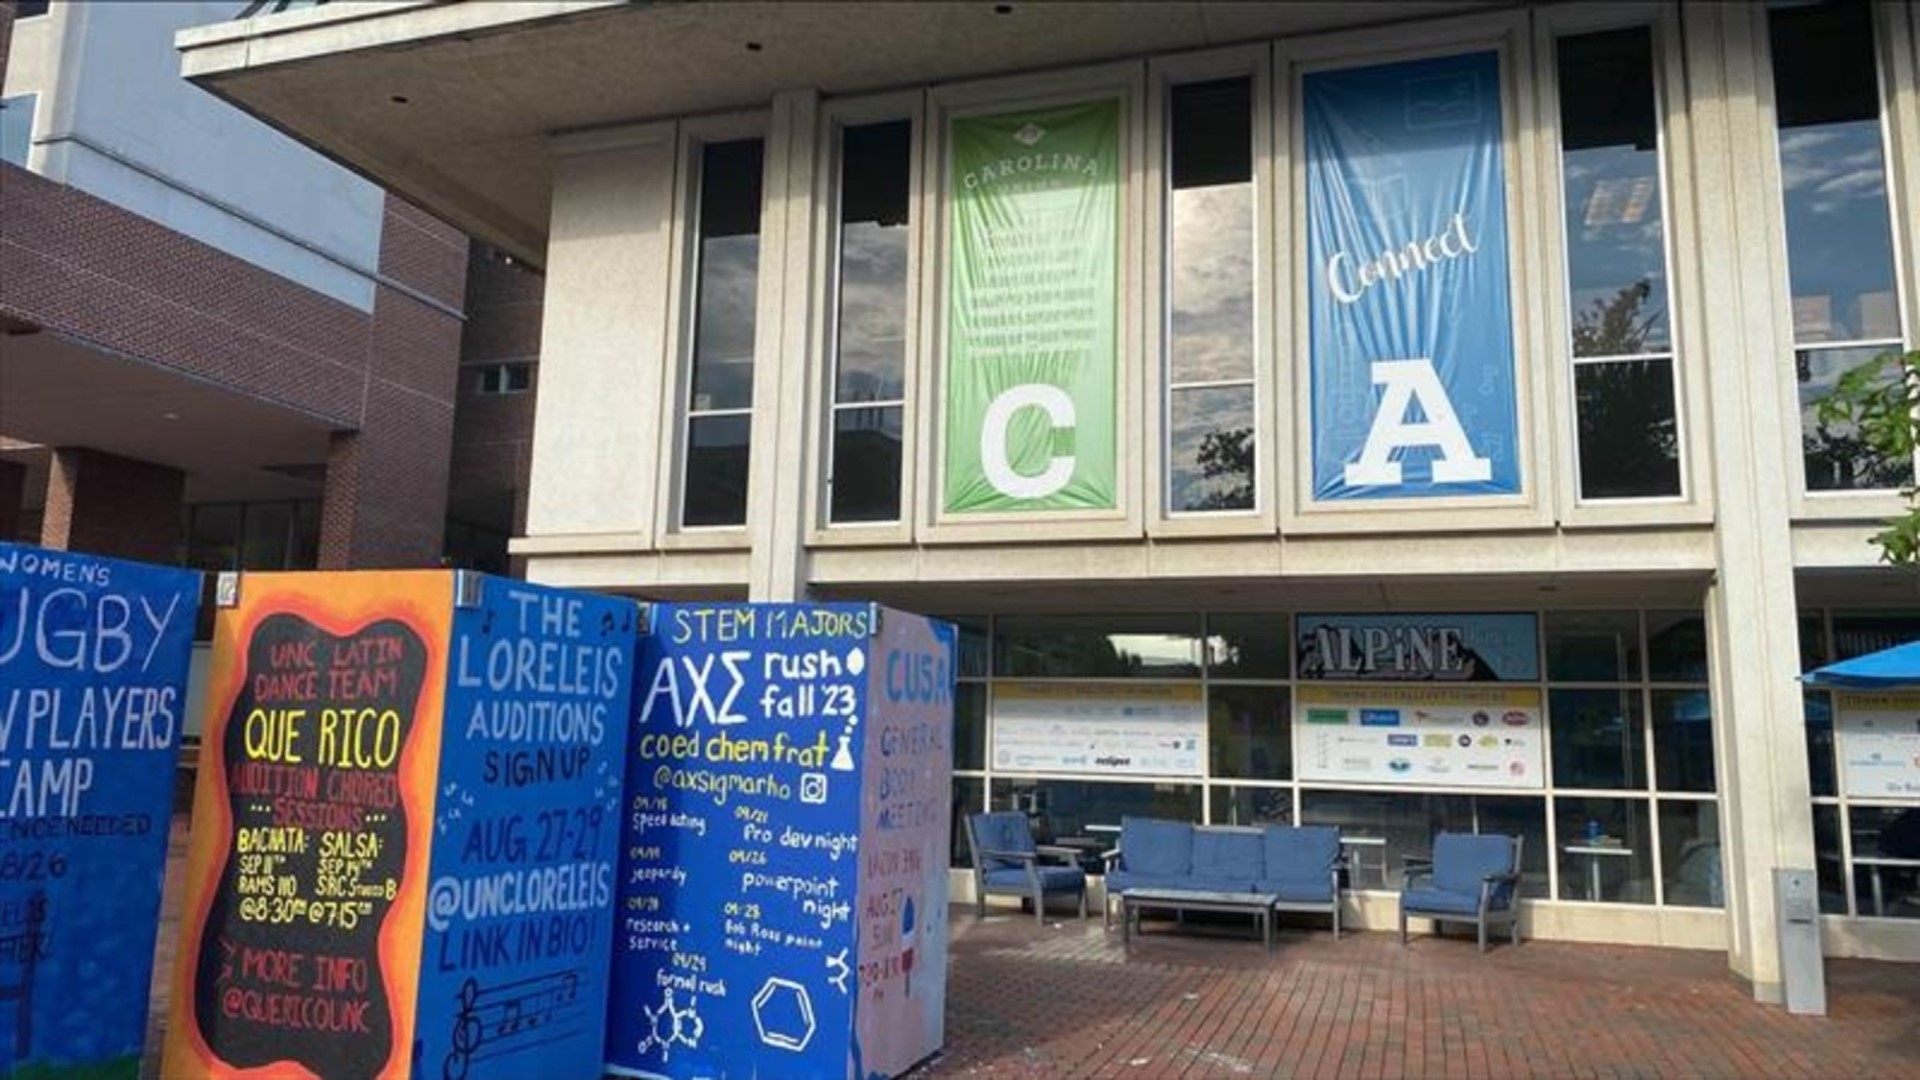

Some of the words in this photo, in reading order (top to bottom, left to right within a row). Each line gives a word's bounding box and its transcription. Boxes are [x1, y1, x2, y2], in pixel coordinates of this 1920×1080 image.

[964, 153, 1100, 190] CAROLINA
[1329, 211, 1480, 303] Connect
[1345, 357, 1492, 486] A
[981, 383, 1077, 500] C
[508, 589, 584, 639] THE
[672, 607, 757, 645] STEM
[765, 609, 868, 640] MAJORS
[270, 641, 317, 669] UNC
[333, 636, 405, 667] LATIN
[456, 633, 624, 700] LORELEIS
[763, 649, 844, 681] rush
[254, 671, 319, 701] DANCE
[328, 668, 399, 699] TEAM
[886, 649, 948, 707] CUSA
[25, 686, 176, 750] PLAYERS
[759, 682, 817, 720] fall
[244, 707, 307, 764] QUE
[317, 706, 400, 769] RICO
[464, 699, 608, 747] AUDITIONS
[880, 722, 944, 758] GENERAL
[482, 746, 556, 789] SIGN
[559, 744, 592, 782] UP
[640, 729, 700, 760] coed
[704, 729, 770, 762] chem
[772, 729, 831, 768] frat
[234, 761, 320, 799] AUDITION
[326, 768, 399, 810] CHOREO
[652, 764, 792, 806] @axsigmarho
[272, 797, 365, 832] SESSIONS
[318, 830, 385, 859] SALSA:
[461, 813, 528, 867] AUG
[535, 804, 605, 865] 27-29
[779, 824, 813, 849] dev
[814, 831, 859, 862] night
[238, 853, 263, 876] SEP
[315, 858, 345, 876] SEP
[629, 865, 688, 888] jeopardy
[237, 874, 276, 897] RAMS
[314, 874, 348, 898] SRC
[385, 877, 398, 902] B
[427, 861, 613, 932] @UNCLORELEIS
[740, 871, 841, 901] powerpoint
[625, 917, 681, 934] research
[802, 898, 852, 931] night
[438, 922, 514, 973] LINK
[516, 917, 546, 965] IN
[548, 912, 599, 959] BIO!
[241, 946, 304, 988] MORE
[312, 955, 370, 993] INFO
[656, 966, 698, 993] formal
[698, 977, 728, 998] rush
[222, 985, 372, 1034] @QUERICOUNC
